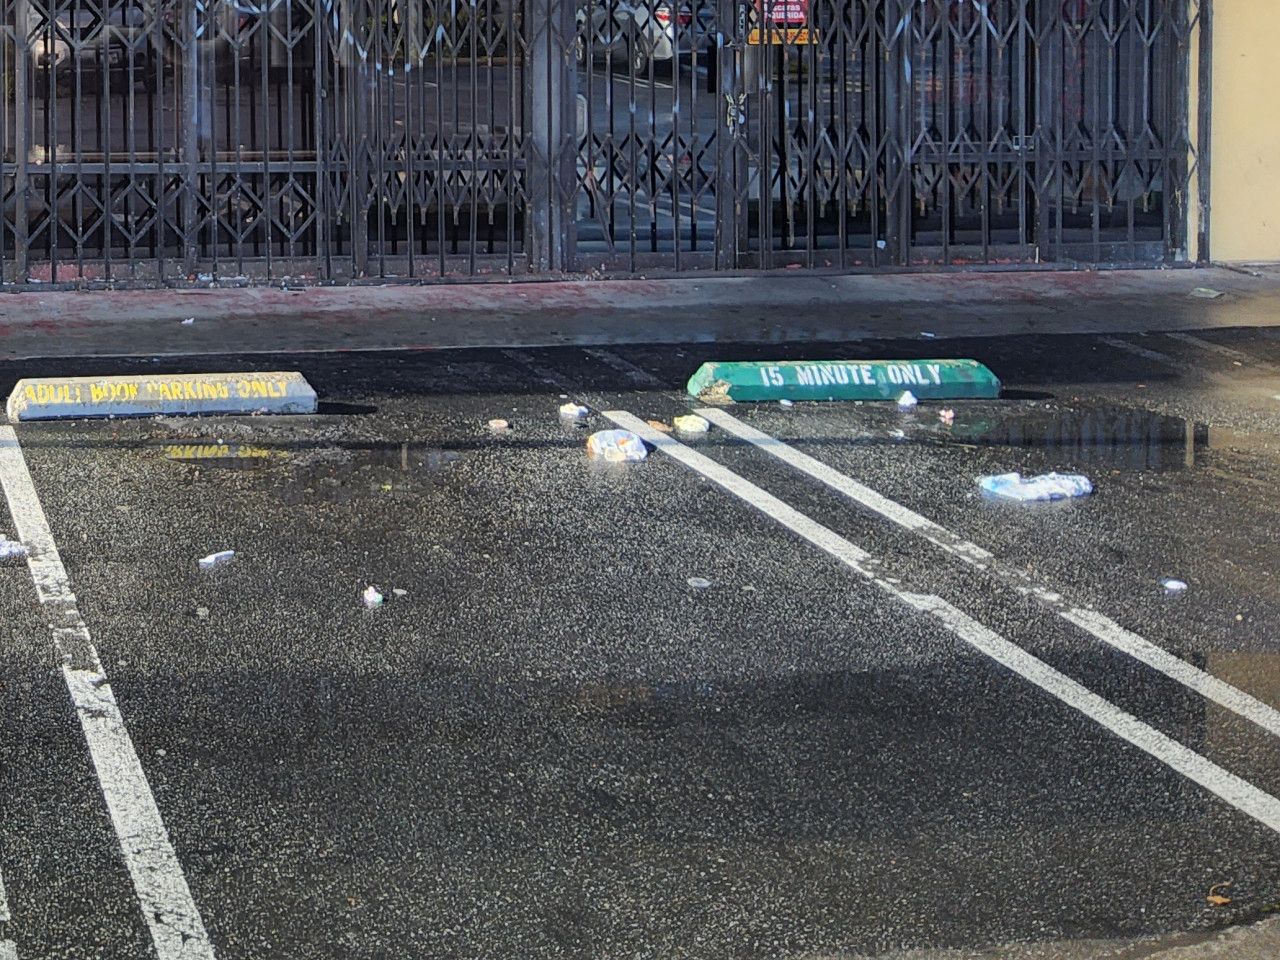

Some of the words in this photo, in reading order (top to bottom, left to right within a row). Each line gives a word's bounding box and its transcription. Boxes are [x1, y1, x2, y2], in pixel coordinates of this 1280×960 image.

[761, 367, 784, 387] 15
[796, 365, 876, 386] MINUTE
[888, 364, 942, 385] ONLY
[147, 381, 229, 400] ARKING
[237, 380, 288, 398] ONLY
